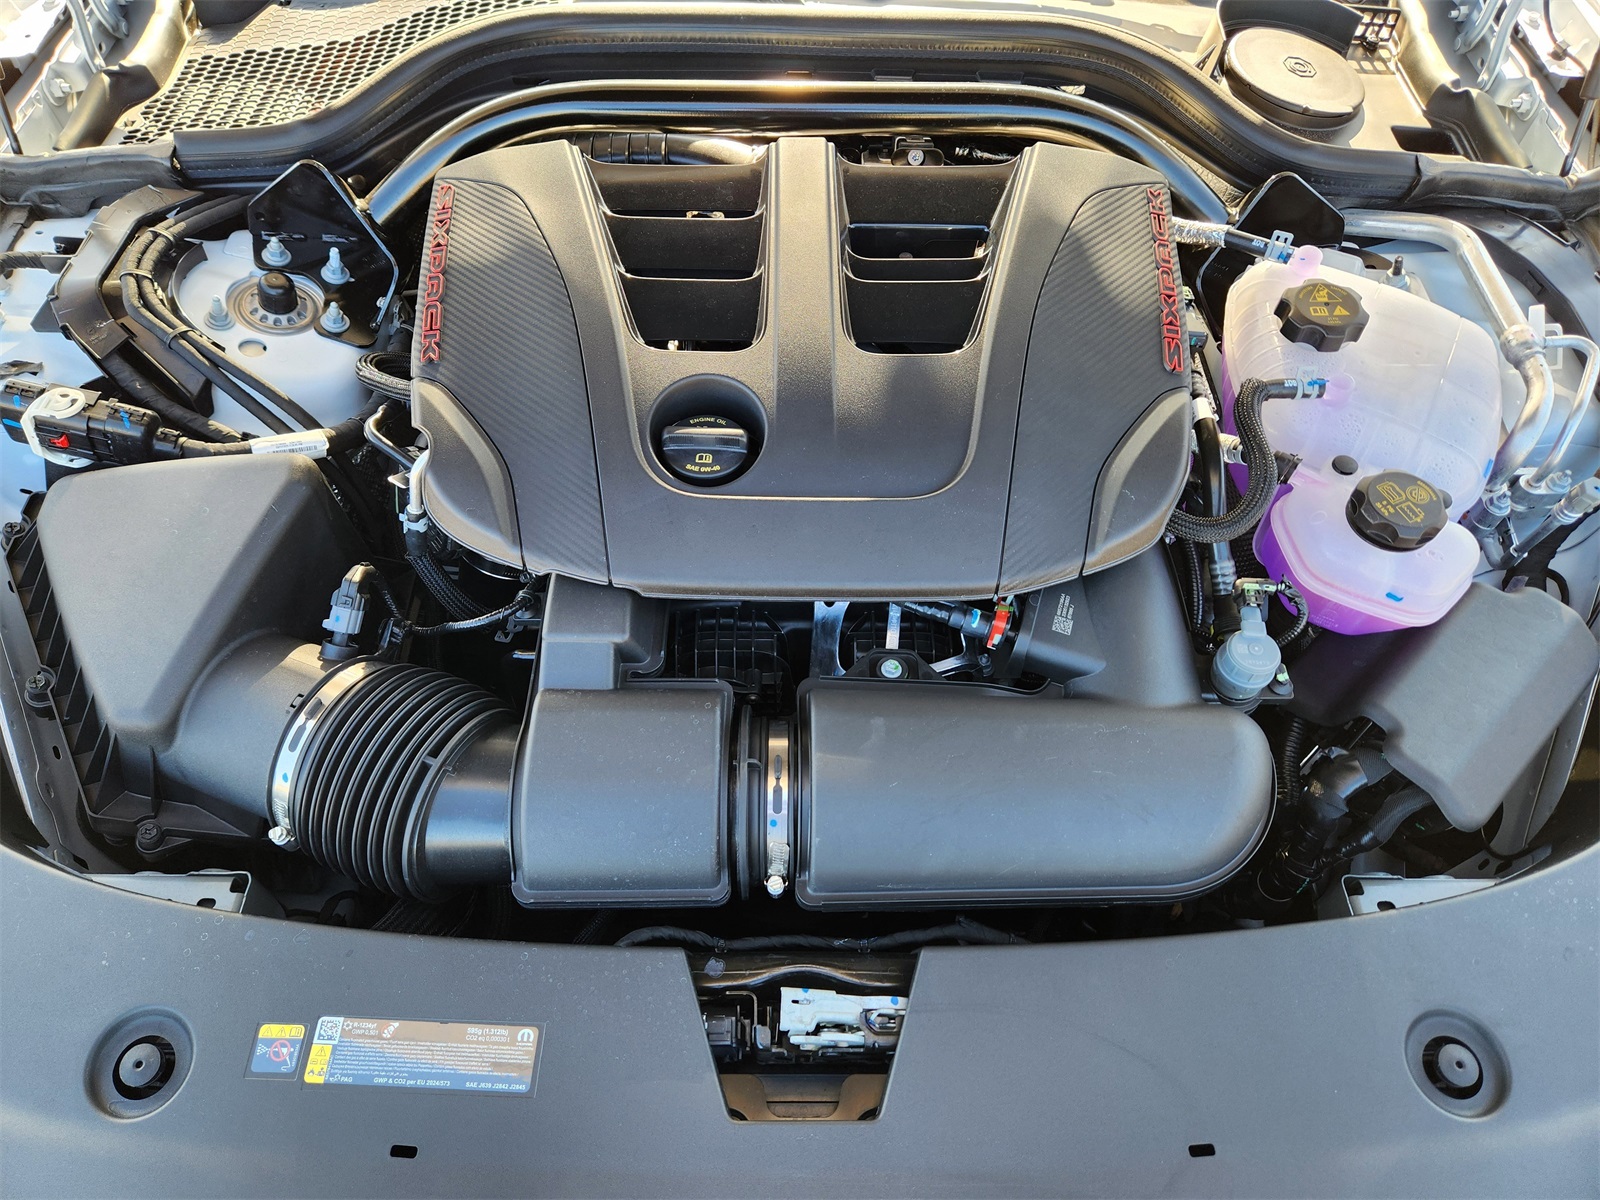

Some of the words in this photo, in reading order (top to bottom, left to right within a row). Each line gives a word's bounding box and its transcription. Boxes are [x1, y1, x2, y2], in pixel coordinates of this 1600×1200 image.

[420, 183, 456, 363] SIXPACK
[1147, 187, 1184, 373] SIXPACK
[685, 463, 700, 472] SAE
[700, 464, 721, 472] 0W-40
[716, 418, 727, 426] OIL
